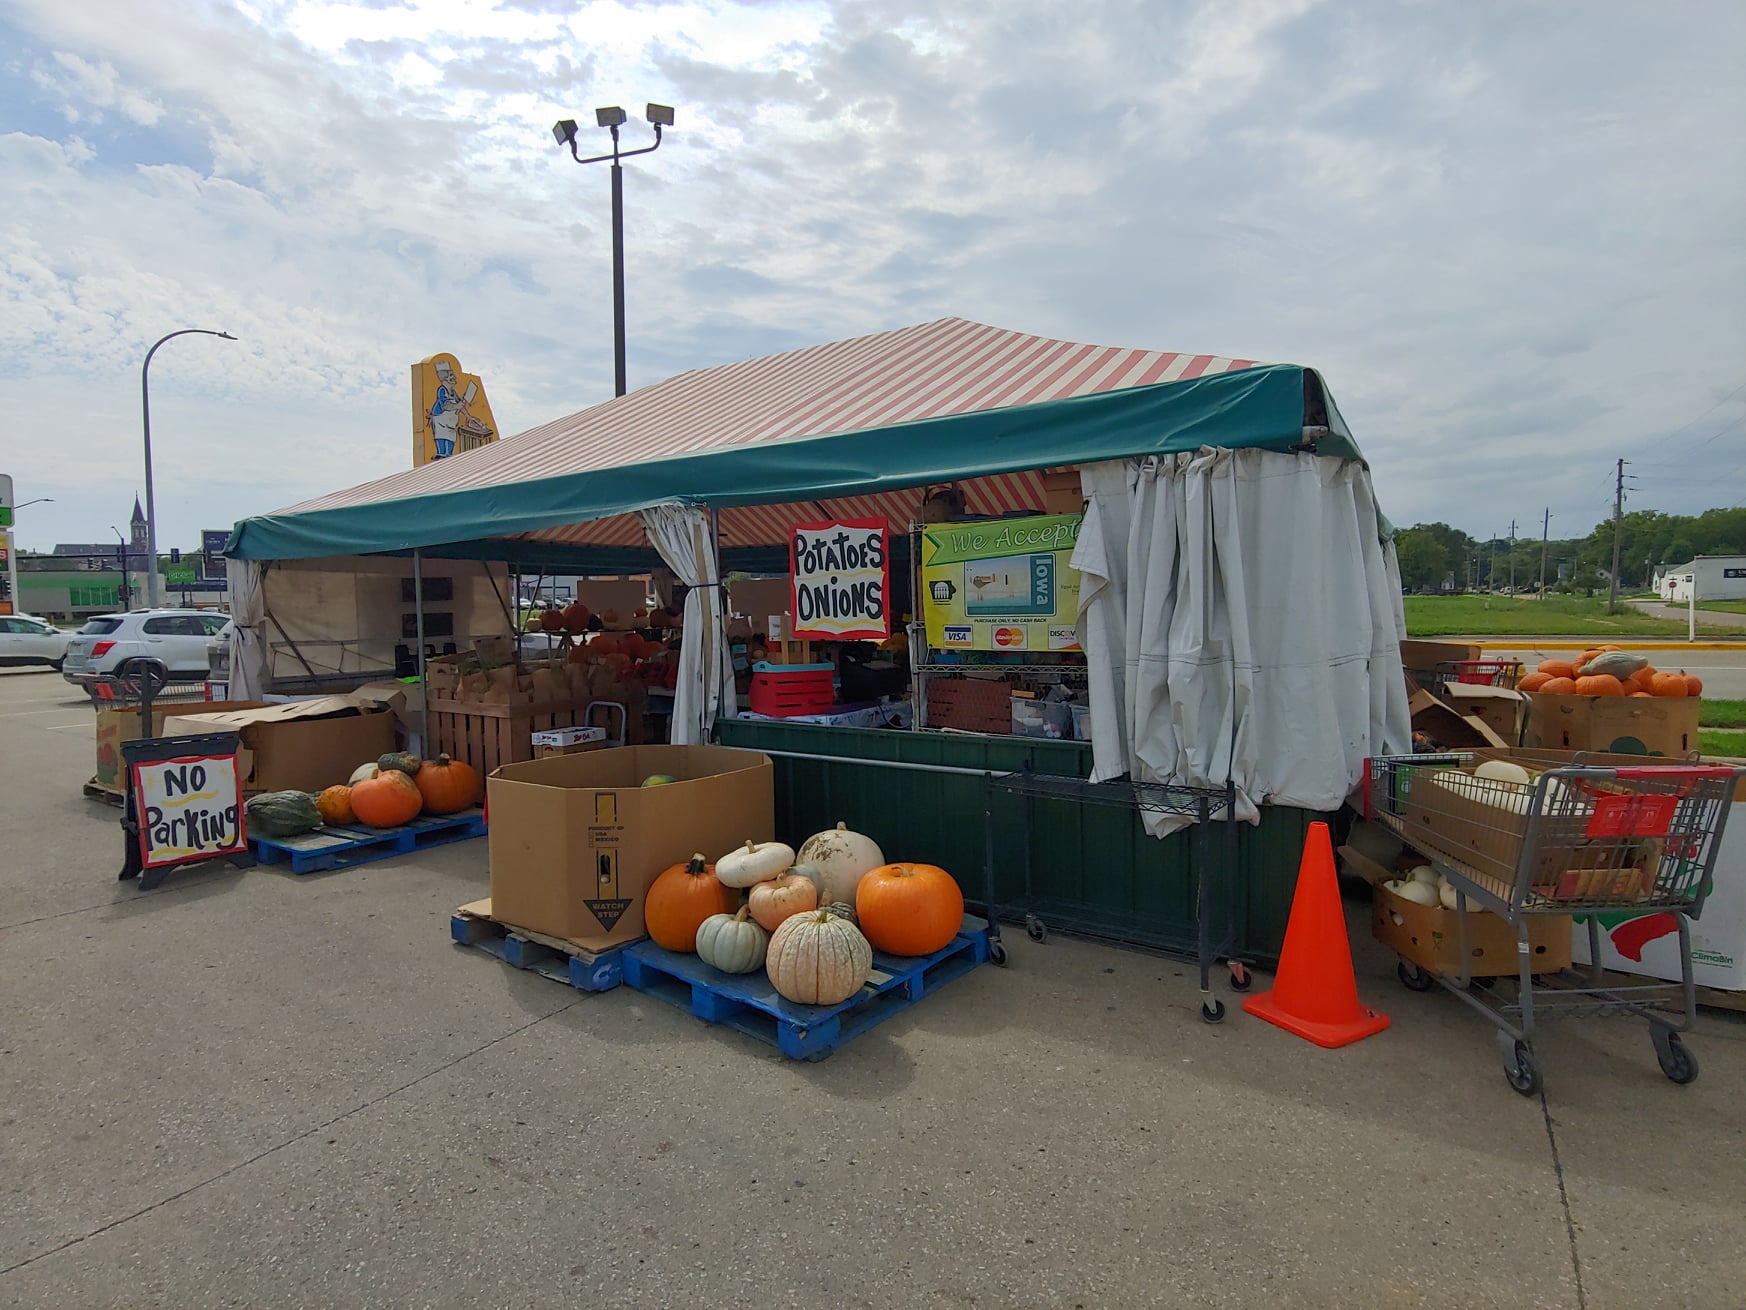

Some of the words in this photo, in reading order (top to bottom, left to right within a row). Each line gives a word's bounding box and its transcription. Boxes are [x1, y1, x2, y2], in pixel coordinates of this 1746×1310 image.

[951, 533, 989, 553] We
[996, 518, 1083, 547] Accept
[1035, 558, 1053, 605] Iowa
[948, 632, 967, 641] VISA
[164, 765, 206, 796] NO
